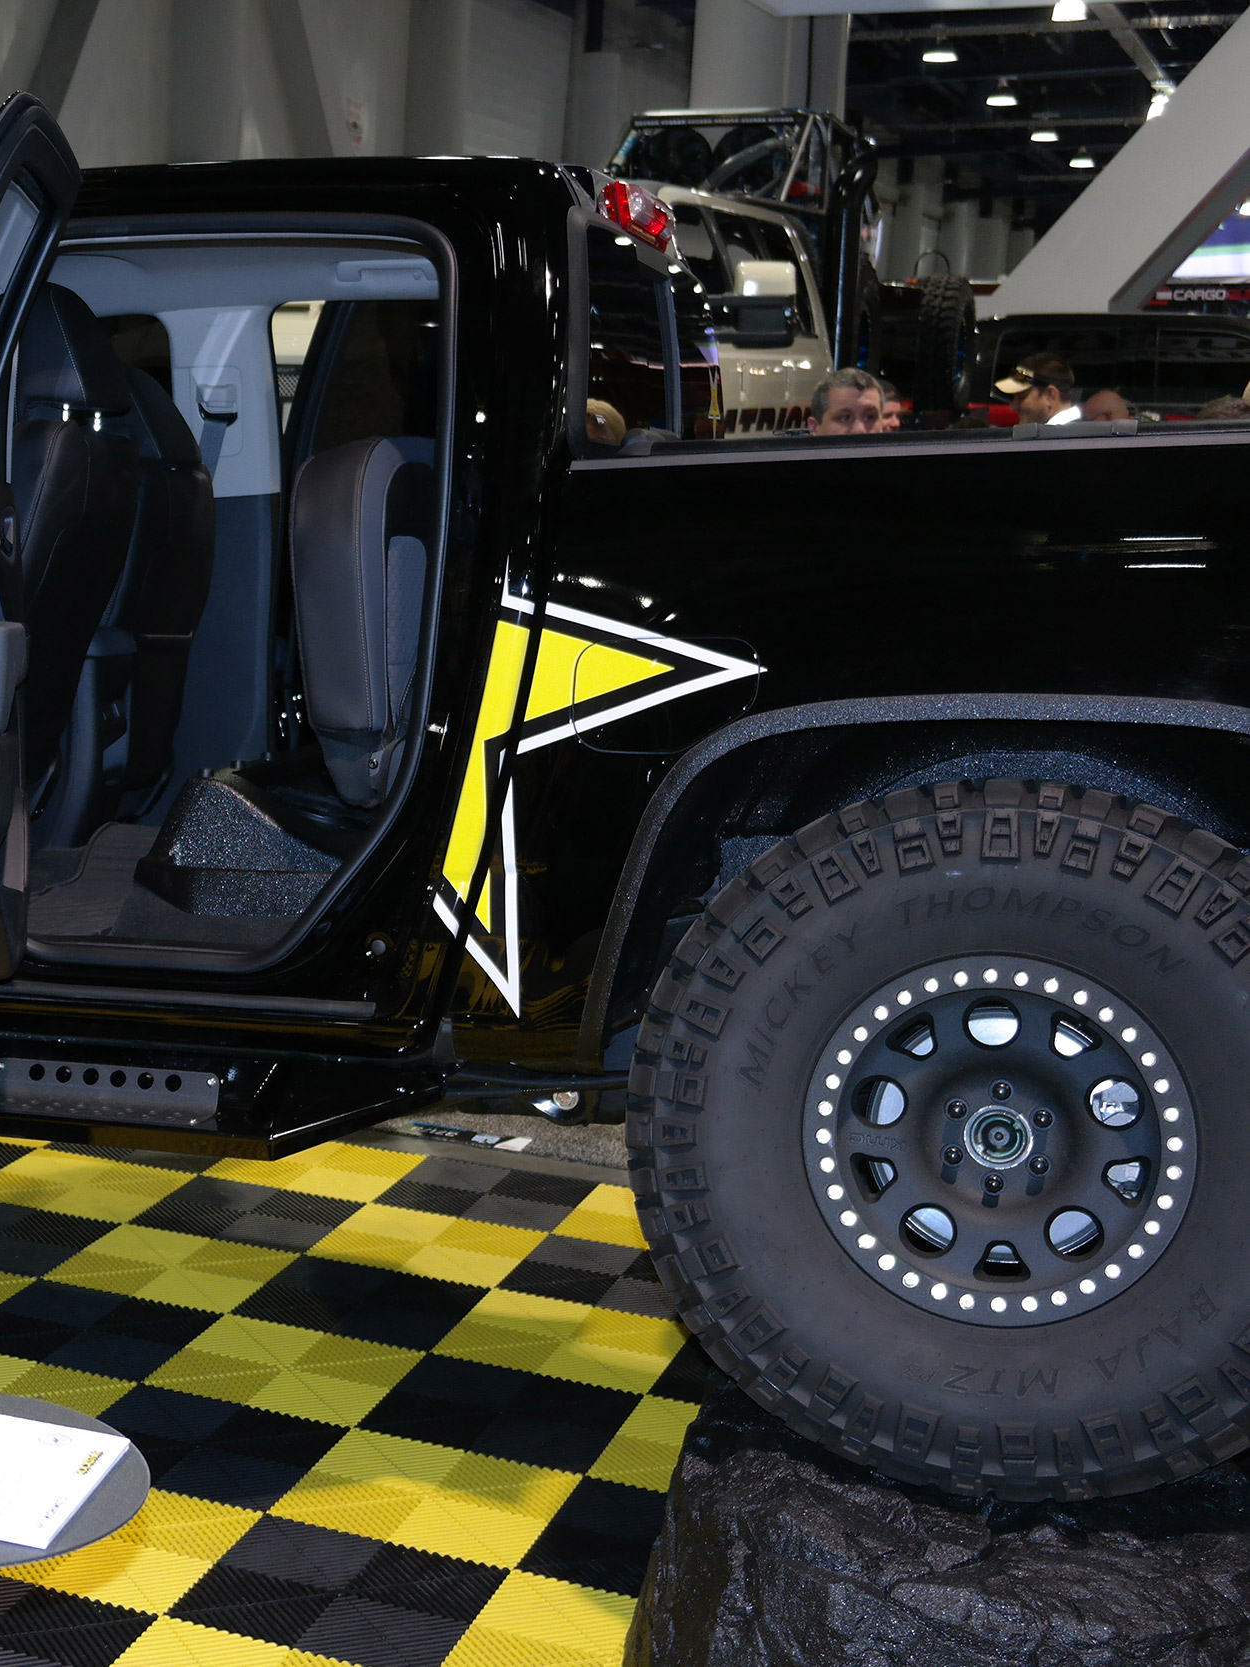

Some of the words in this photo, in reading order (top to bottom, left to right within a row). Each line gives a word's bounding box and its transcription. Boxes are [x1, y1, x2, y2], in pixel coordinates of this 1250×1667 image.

[736, 923, 869, 1088] MICKEY
[895, 886, 1188, 977] THOMPSON
[941, 1362, 1062, 1400] MTZ
[1088, 1284, 1220, 1384] BAJA
